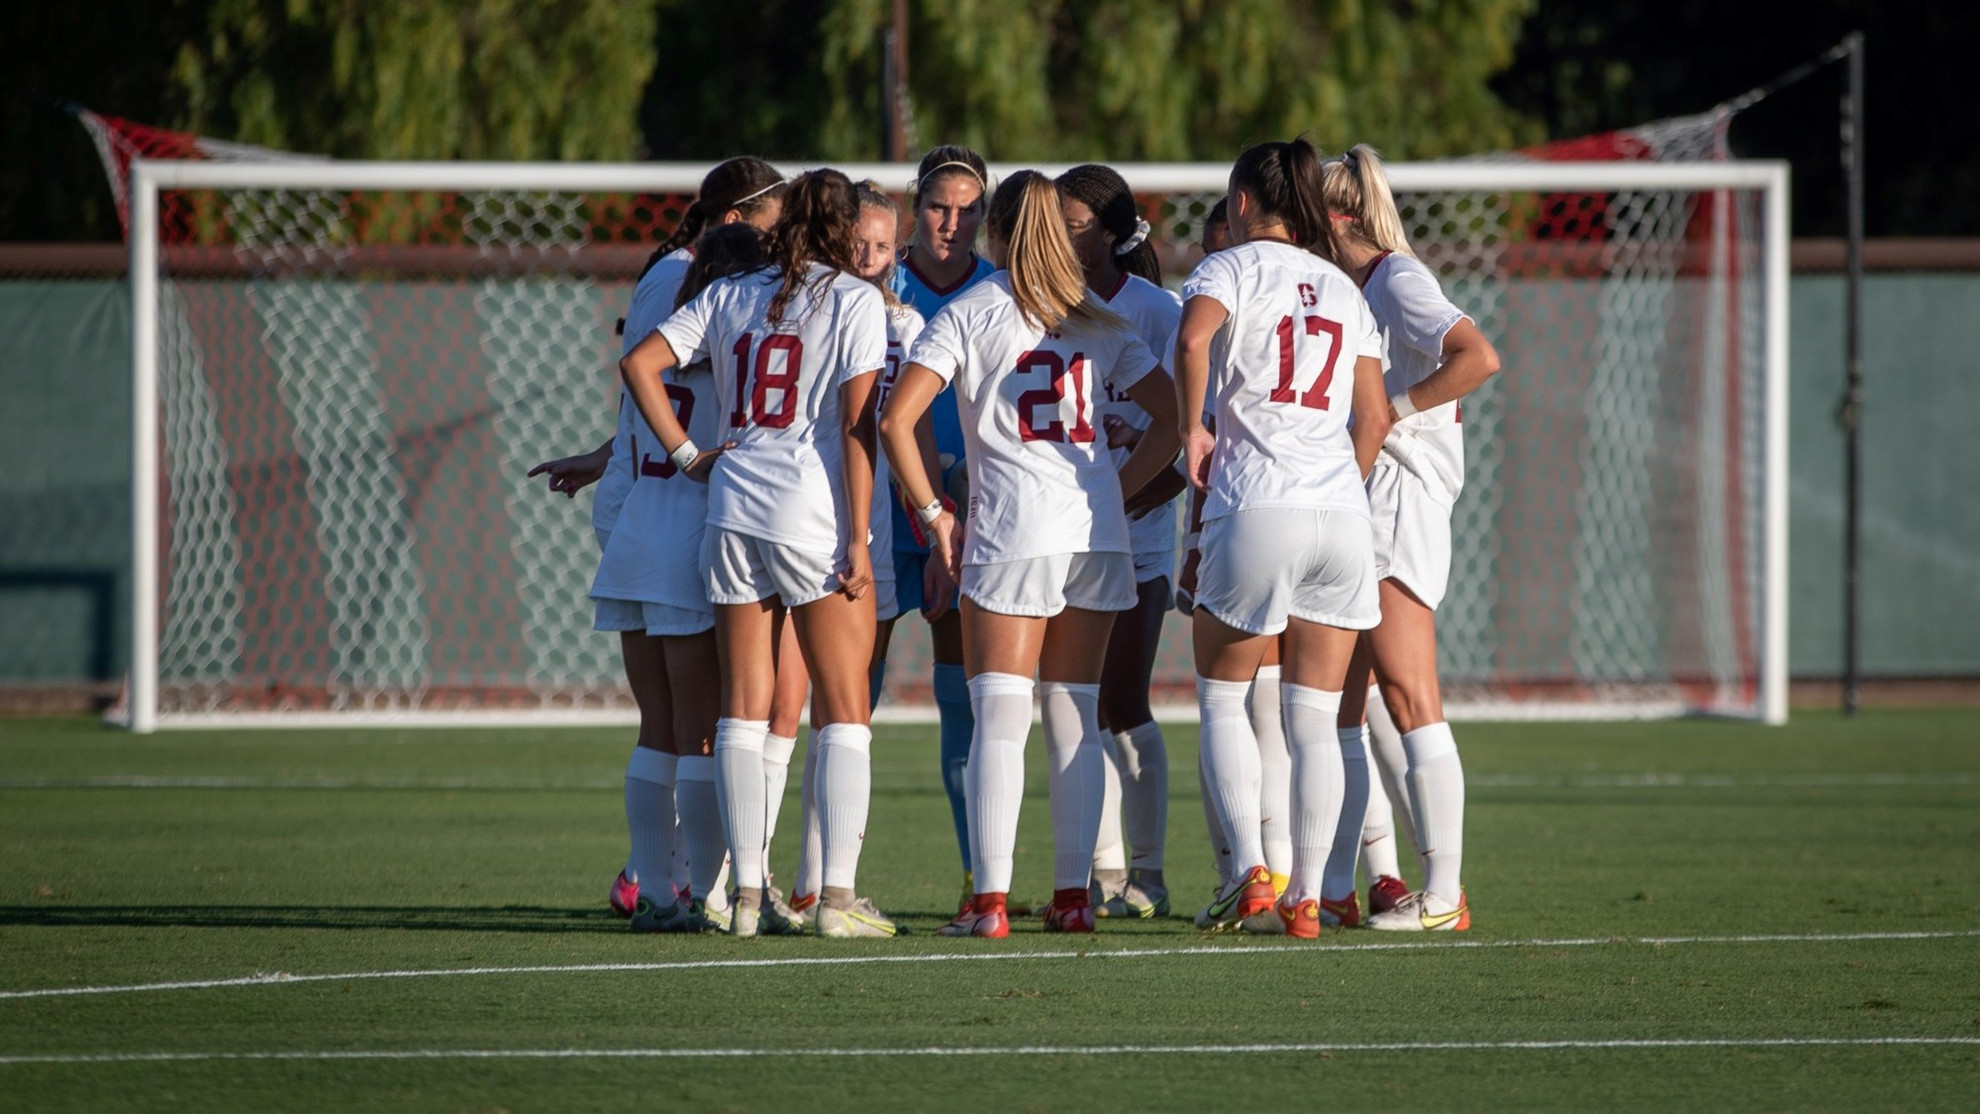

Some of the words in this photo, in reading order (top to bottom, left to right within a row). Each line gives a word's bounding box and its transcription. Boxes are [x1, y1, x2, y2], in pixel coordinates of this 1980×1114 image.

[730, 333, 803, 429] 18
[1016, 350, 1096, 443] 21
[1269, 314, 1343, 411] 17
